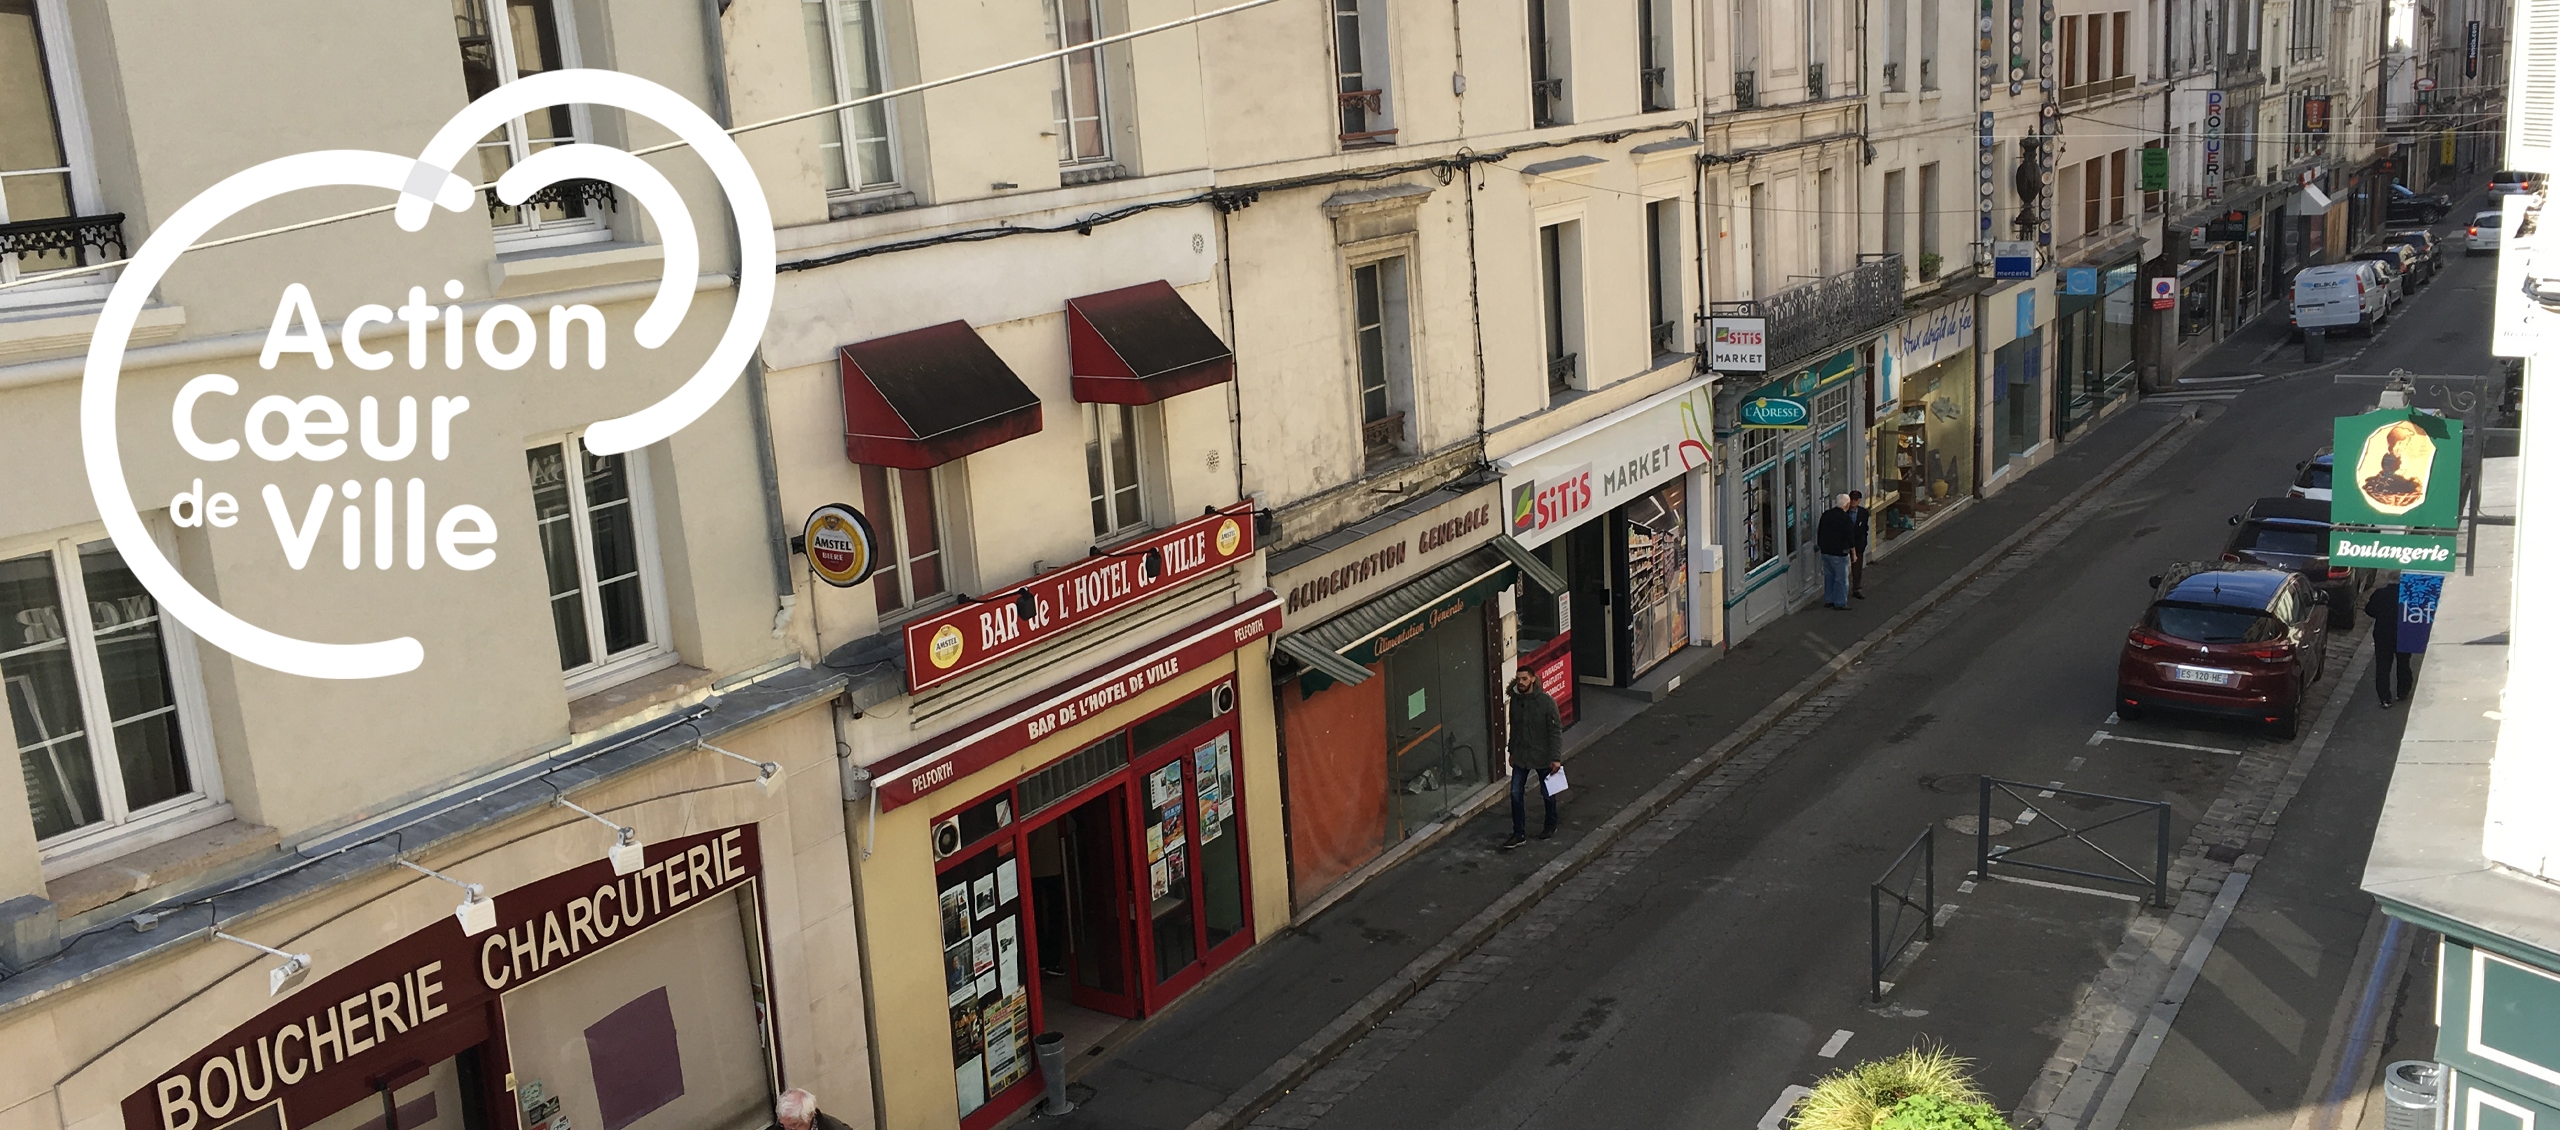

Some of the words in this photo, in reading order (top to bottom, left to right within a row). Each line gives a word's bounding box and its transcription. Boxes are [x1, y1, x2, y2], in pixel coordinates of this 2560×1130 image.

[2205, 92, 2223, 199] DROGUERIE
[1715, 353, 1763, 364] MARKET
[1603, 443, 1670, 497] MARKET
[814, 536, 852, 551] AMSTEL
[1287, 540, 1406, 616] ALIMENTATION
[1418, 503, 1490, 554] GENERALE
[2336, 539, 2450, 564] Boulangerie
[979, 602, 1020, 651] BAR
[1138, 552, 1157, 588] d
[1163, 530, 1206, 577] VILLE
[935, 636, 957, 651] AMSTEL
[1234, 618, 1265, 643] PELFORTH
[1374, 621, 1425, 657] Alimentation
[1028, 714, 1056, 740] BAR
[1059, 703, 1077, 725] DE
[1079, 681, 1128, 717] L'HOTEL
[1129, 673, 1144, 693] DE
[1146, 657, 1179, 685] VILLE
[911, 760, 954, 794] PELFORTH
[157, 960, 449, 1130] BOUCHERIE
[481, 827, 746, 990] CHARCUTERIE
